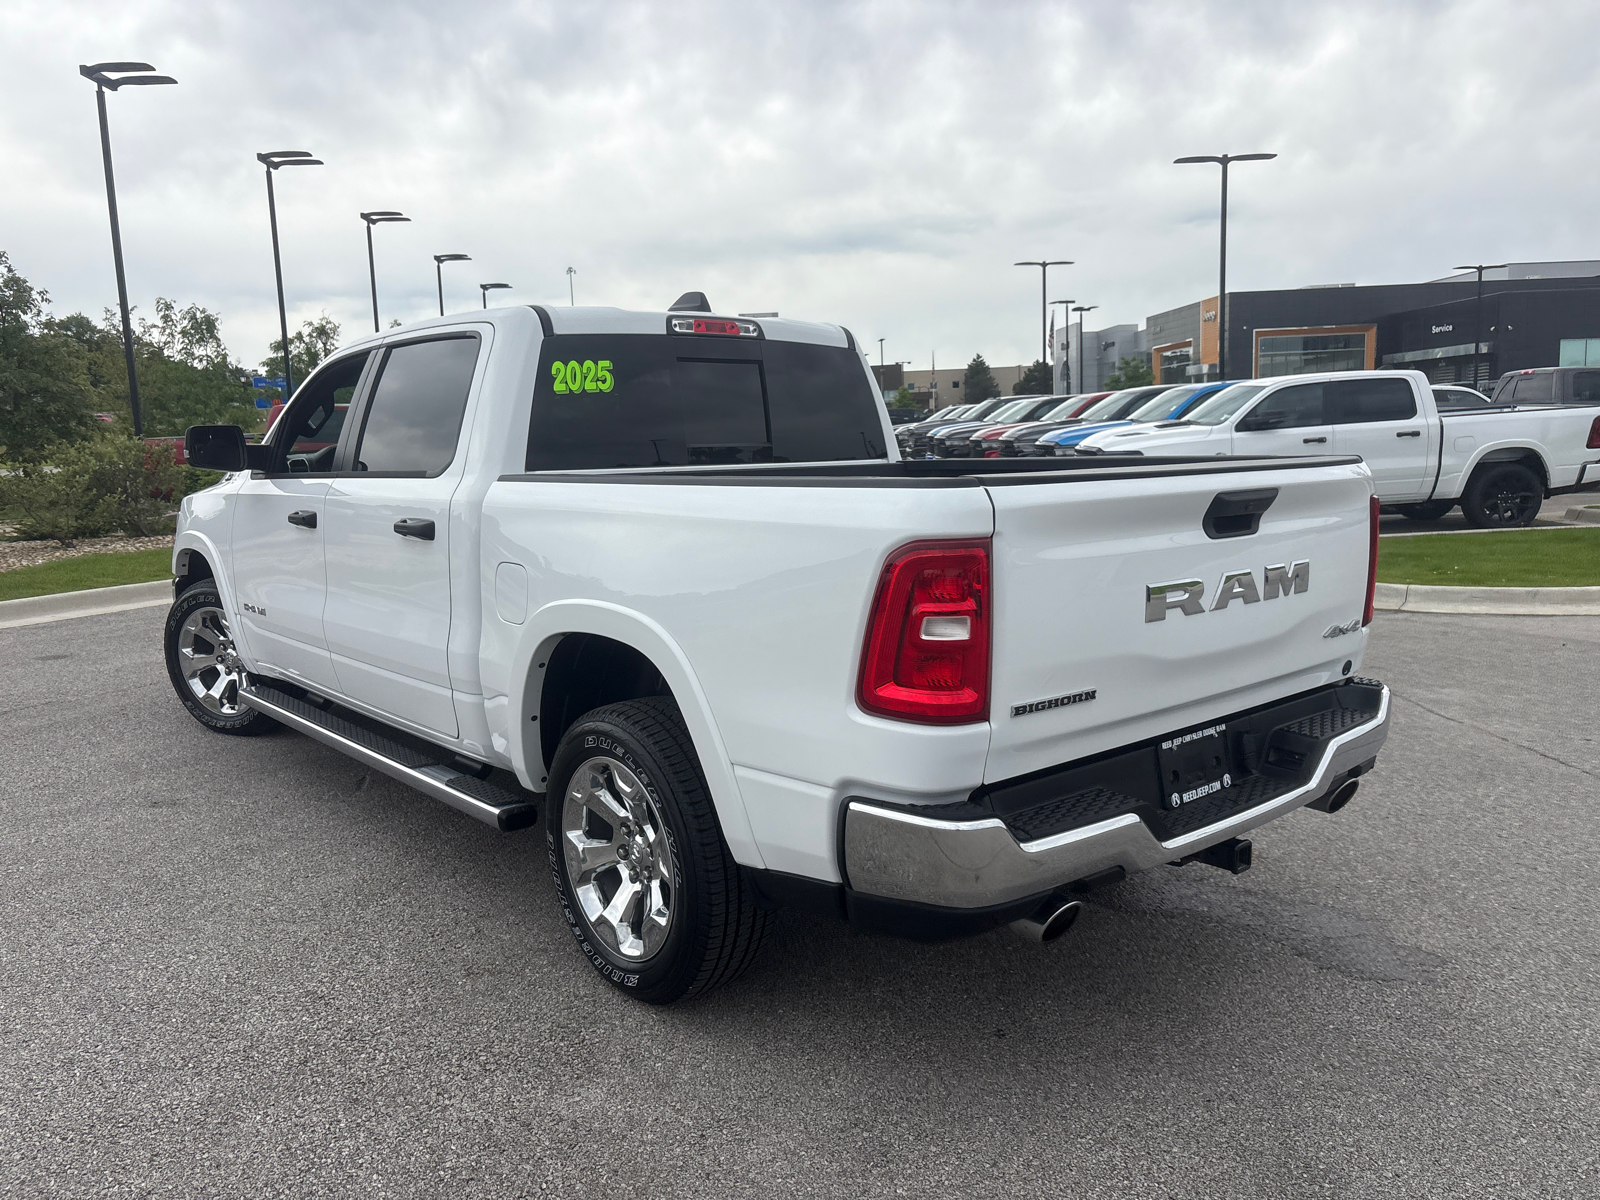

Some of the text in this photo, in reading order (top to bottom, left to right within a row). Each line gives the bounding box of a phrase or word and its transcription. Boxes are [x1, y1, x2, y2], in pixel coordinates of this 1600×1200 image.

[1431, 324, 1453, 334] Service
[551, 359, 615, 395] 2025
[1145, 558, 1310, 624] RAM
[1011, 687, 1097, 718] BIGHORN
[1161, 723, 1226, 750] REED JEEP CHRYSLER DODGE RAM
[584, 735, 663, 809] DUELER
[1182, 780, 1221, 803] REEDJEEP.COM
